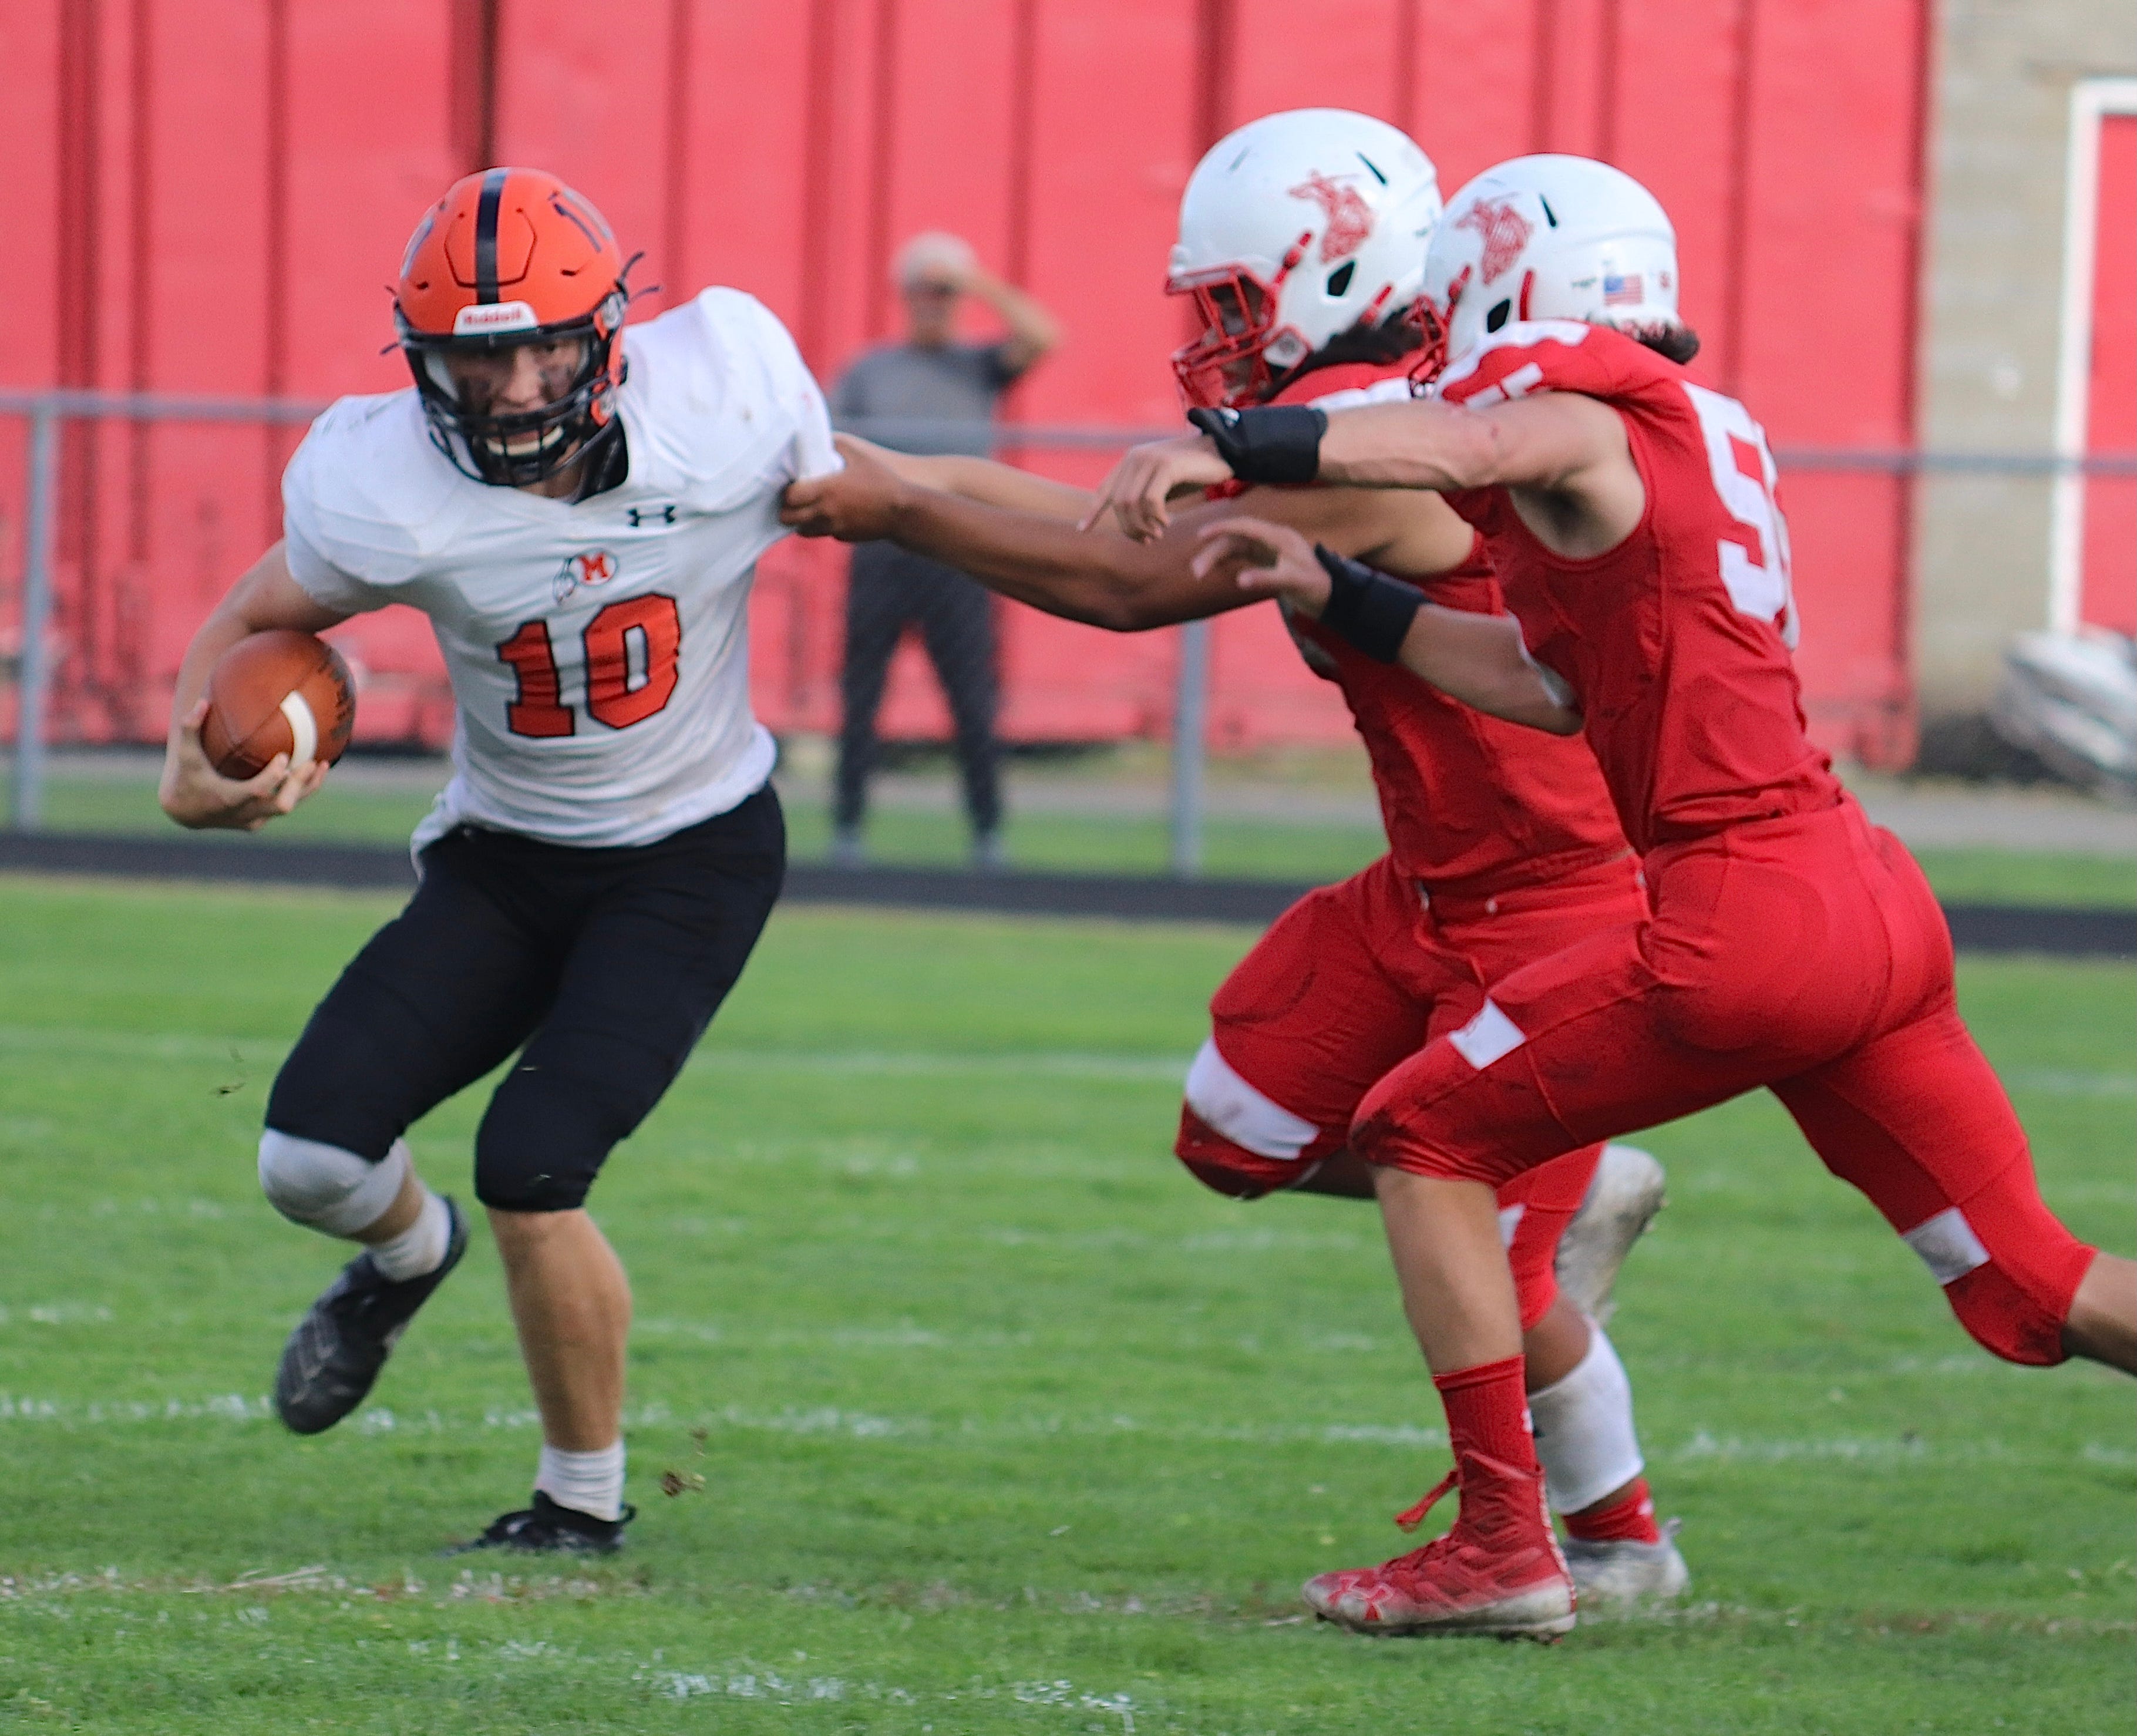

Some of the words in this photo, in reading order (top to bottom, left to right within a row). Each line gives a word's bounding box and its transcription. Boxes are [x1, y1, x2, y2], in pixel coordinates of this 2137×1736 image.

[578, 551, 608, 581] M
[1681, 379, 1801, 652] 5
[495, 591, 681, 738] 10
